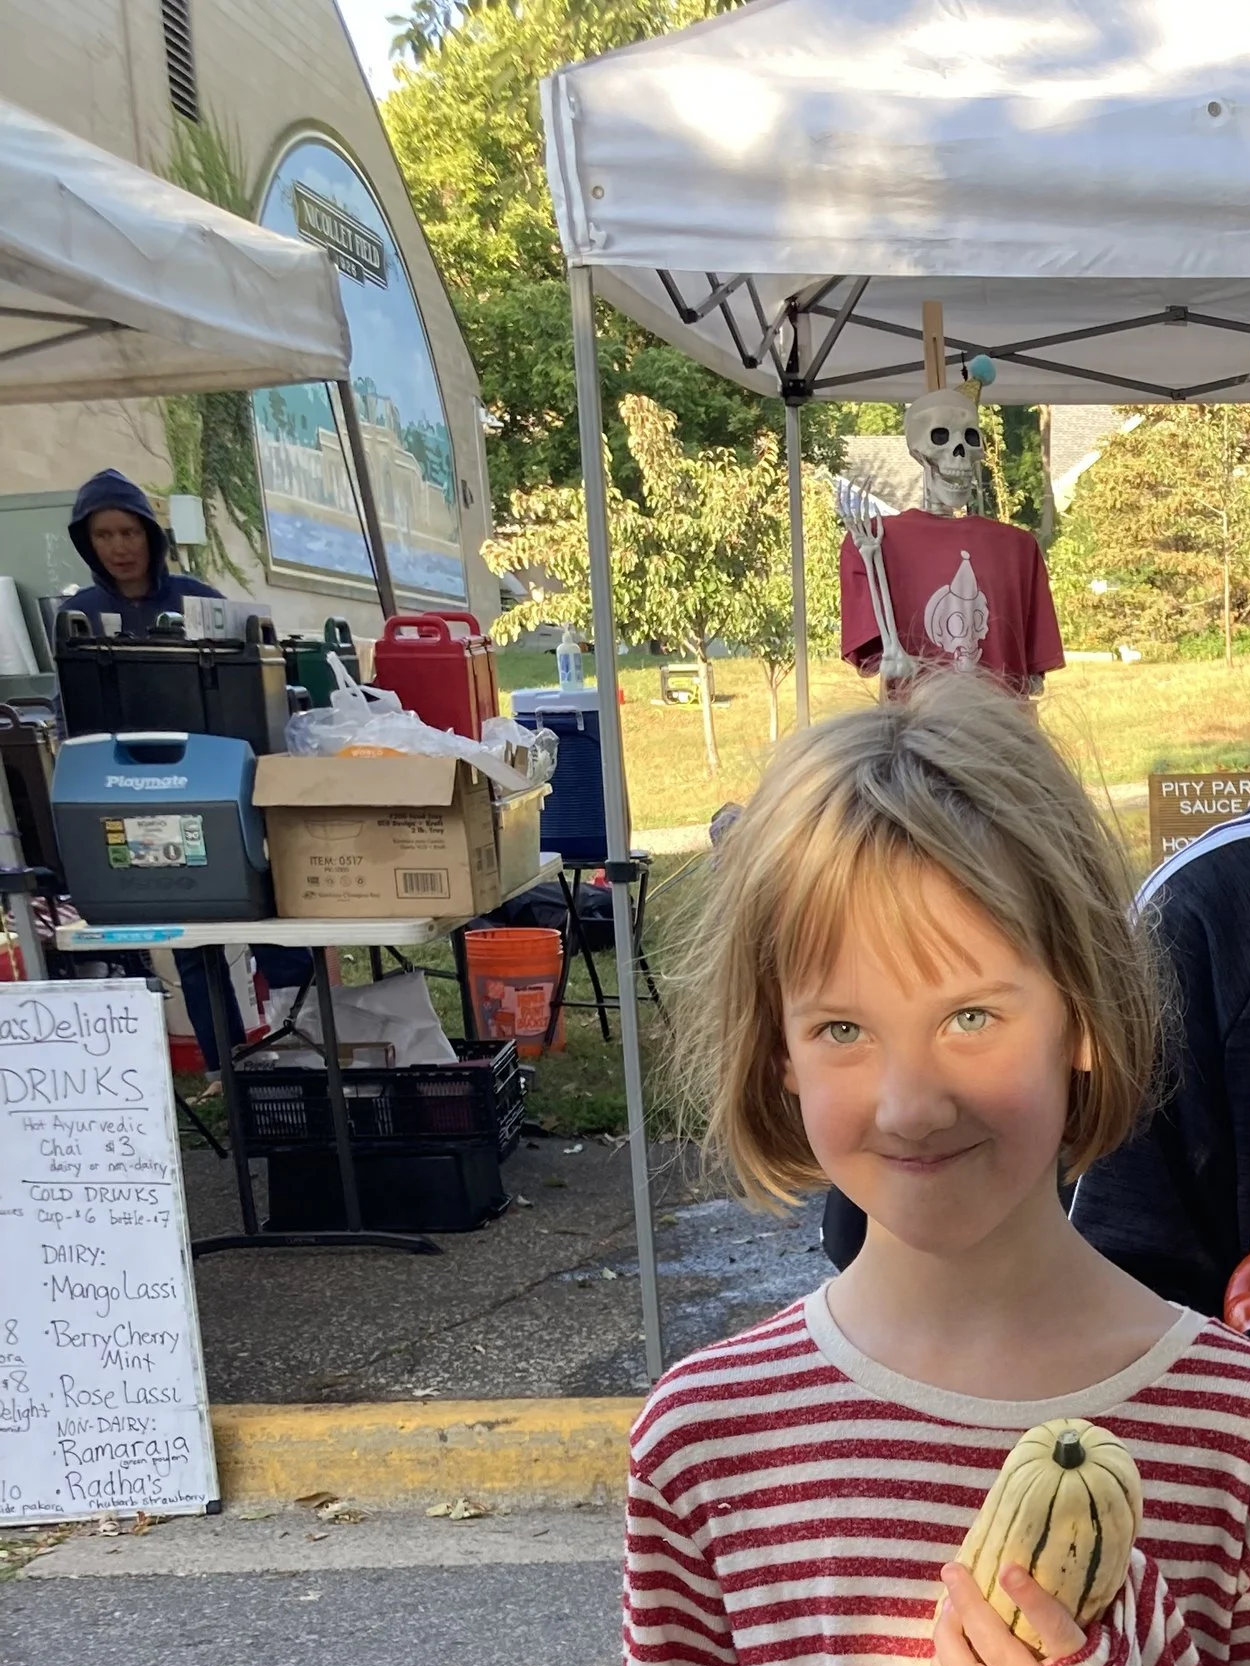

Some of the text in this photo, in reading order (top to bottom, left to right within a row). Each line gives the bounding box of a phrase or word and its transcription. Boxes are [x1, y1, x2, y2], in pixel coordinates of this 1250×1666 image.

[302, 199, 381, 270] NICOLLET FIELD
[104, 775, 189, 791] Playmate
[1161, 780, 1205, 798] PITY
[1179, 798, 1243, 815] SAUCE
[309, 855, 364, 867] ITEM: 0517
[18, 999, 139, 1057] Delight
[0, 1066, 144, 1104] DRINKS
[53, 1114, 147, 1138] Ayurvedic
[40, 1138, 82, 1157] Chai
[50, 1158, 82, 1178] dairy
[30, 1185, 160, 1205] COLD DRINKS
[42, 1244, 106, 1266] DAIRY:
[51, 1270, 177, 1318] Mango Lassi
[50, 1320, 180, 1360] Berry Cherry
[102, 1350, 156, 1372] Mint
[59, 1374, 182, 1409] Rose Lassi
[57, 1416, 156, 1437] NON-DAIRY:
[65, 1470, 163, 1500] Radha's
[22, 1500, 65, 1516] pakora
